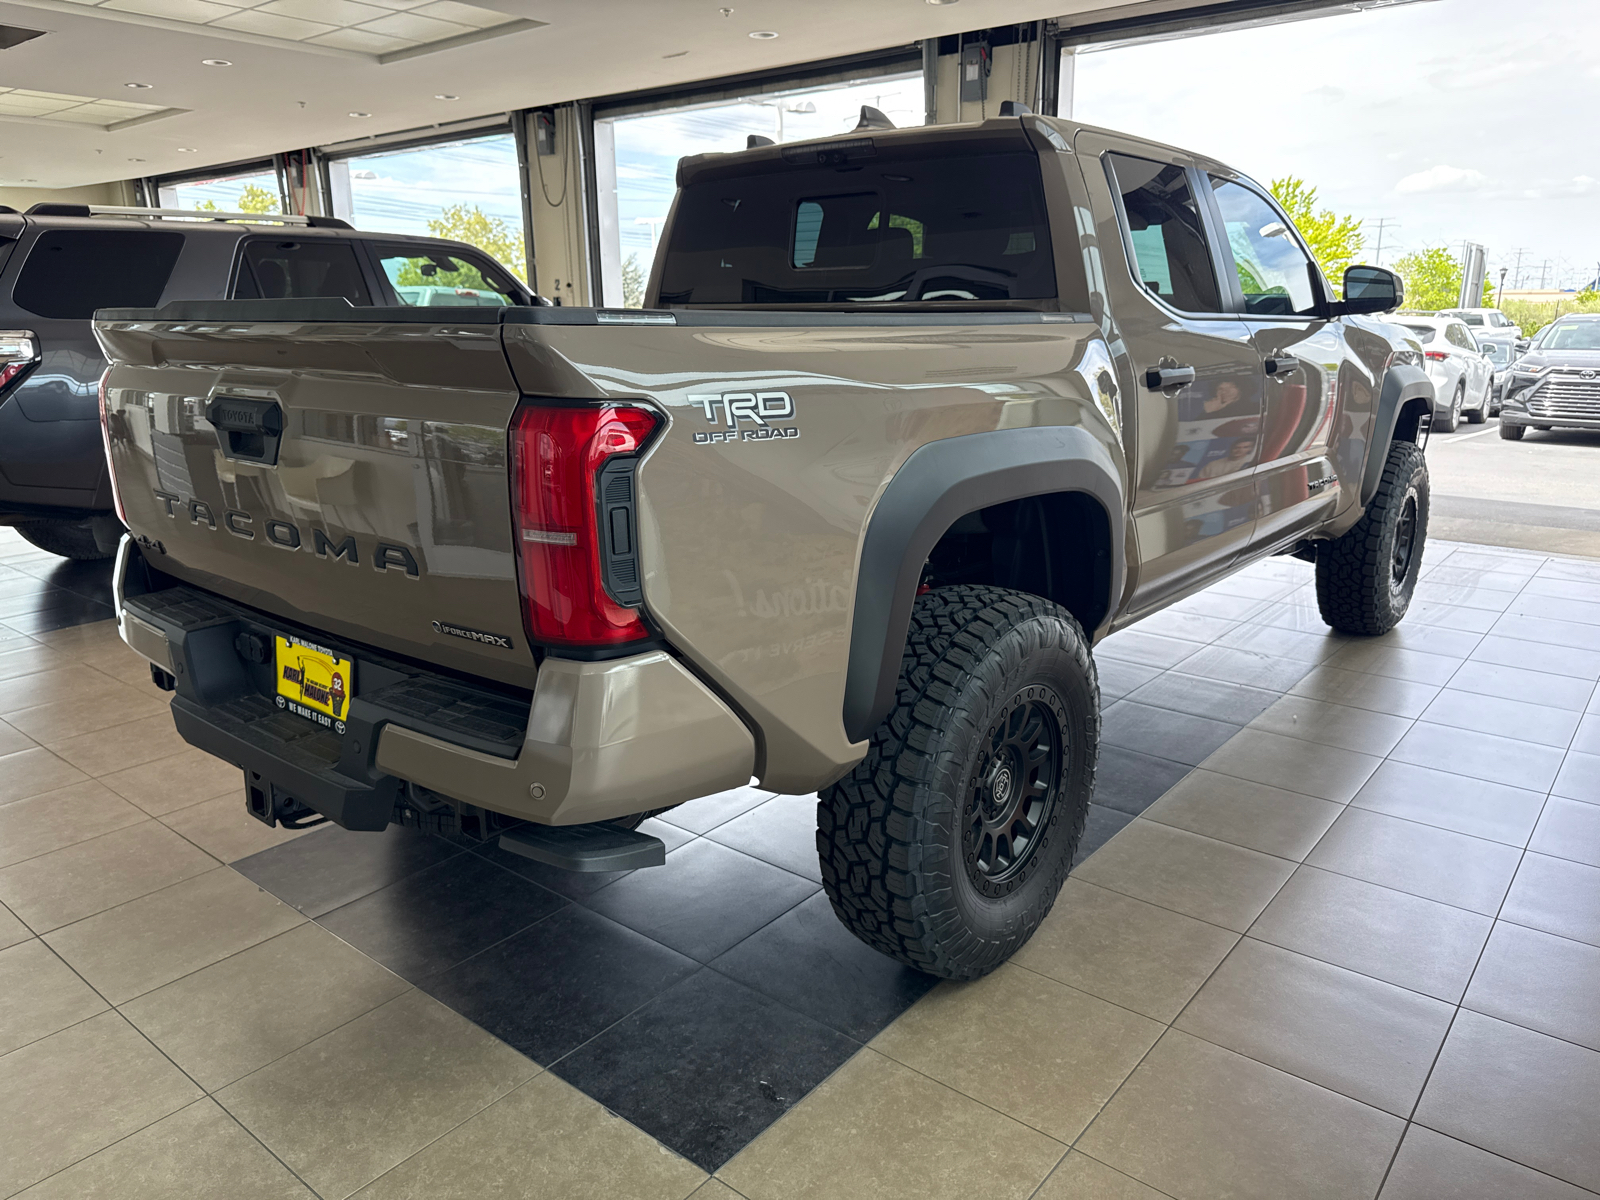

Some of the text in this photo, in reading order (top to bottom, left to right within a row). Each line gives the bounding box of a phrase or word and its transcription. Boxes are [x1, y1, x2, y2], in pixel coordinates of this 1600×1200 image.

[554, 279, 561, 291] 2
[222, 409, 255, 425] TOYOTA
[686, 391, 796, 431] TRD
[692, 426, 800, 445] OFF ROAD
[153, 487, 420, 581] TACOMA
[289, 635, 301, 646] KARL
[300, 639, 318, 652] MALONE
[283, 665, 302, 685] KARL
[333, 678, 342, 691] 32
[304, 682, 330, 707] MALONE
[288, 701, 332, 728] WE MAKE IT EASY
